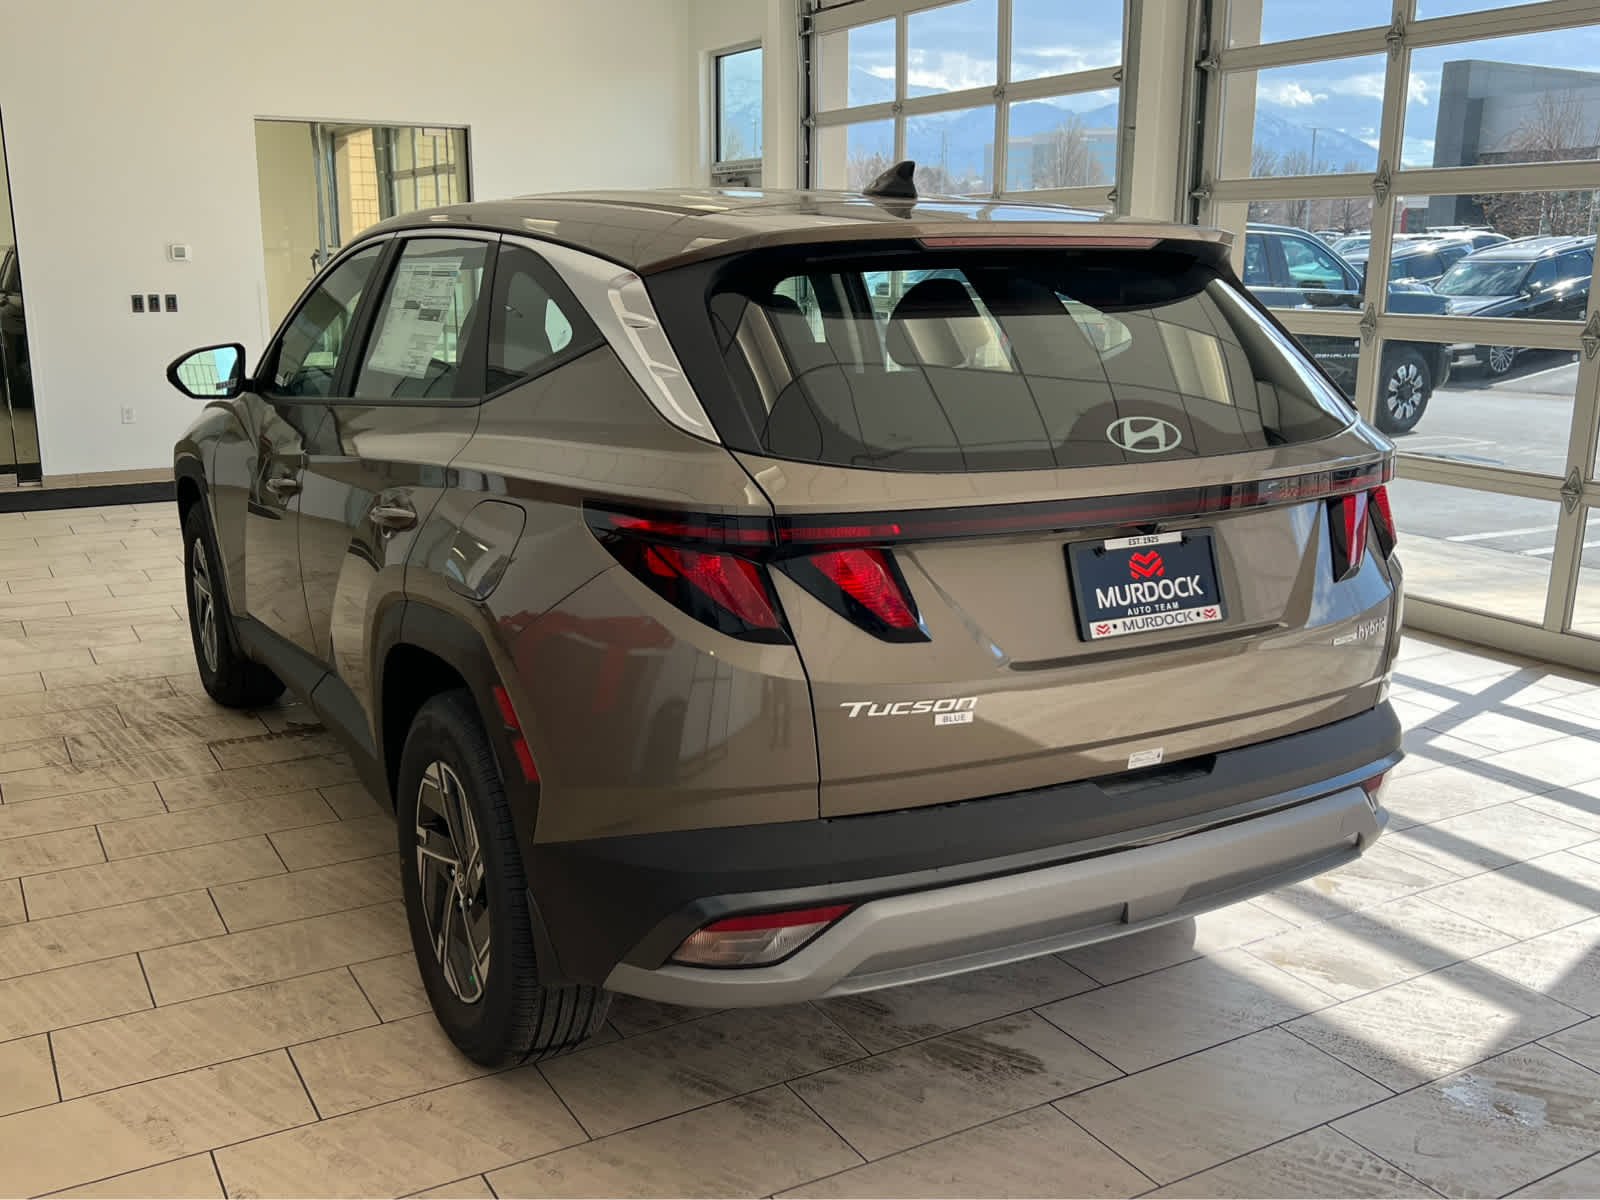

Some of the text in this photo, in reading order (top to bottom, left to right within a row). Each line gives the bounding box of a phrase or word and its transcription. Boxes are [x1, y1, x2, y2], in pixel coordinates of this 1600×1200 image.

[1096, 575, 1203, 609] MURDOCK
[1127, 601, 1180, 616] AUTO TEAM
[1122, 610, 1194, 632] MURDOCK
[943, 714, 966, 723] BLUE
